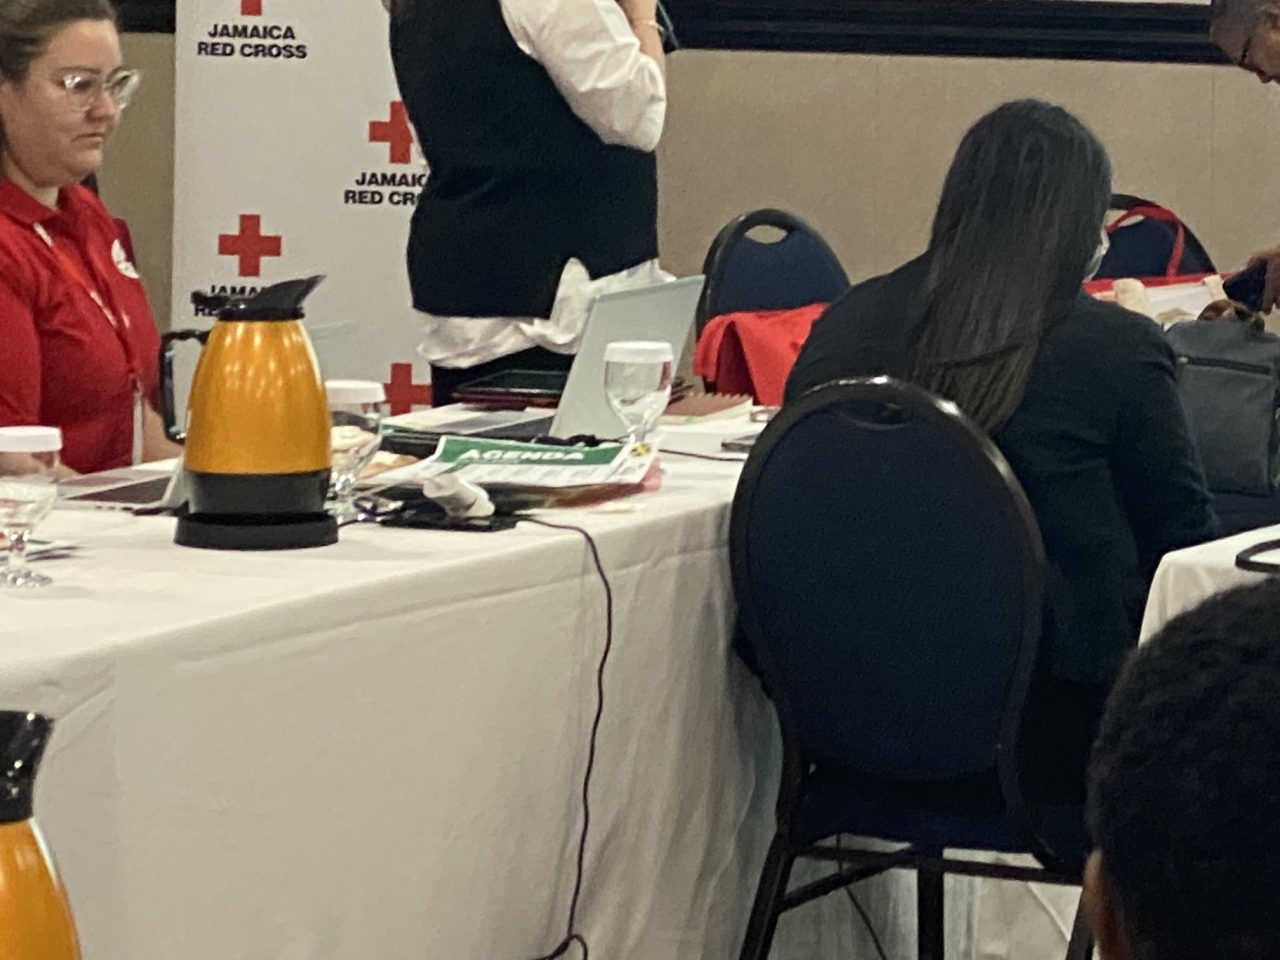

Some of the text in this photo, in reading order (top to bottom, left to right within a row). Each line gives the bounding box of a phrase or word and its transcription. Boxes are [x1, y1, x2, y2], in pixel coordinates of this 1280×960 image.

[208, 23, 296, 40] JAMAICA
[197, 41, 308, 59] RED CROSS
[355, 172, 426, 188] JAMAIC
[344, 189, 383, 205] RED
[458, 448, 585, 461] AGENDA
